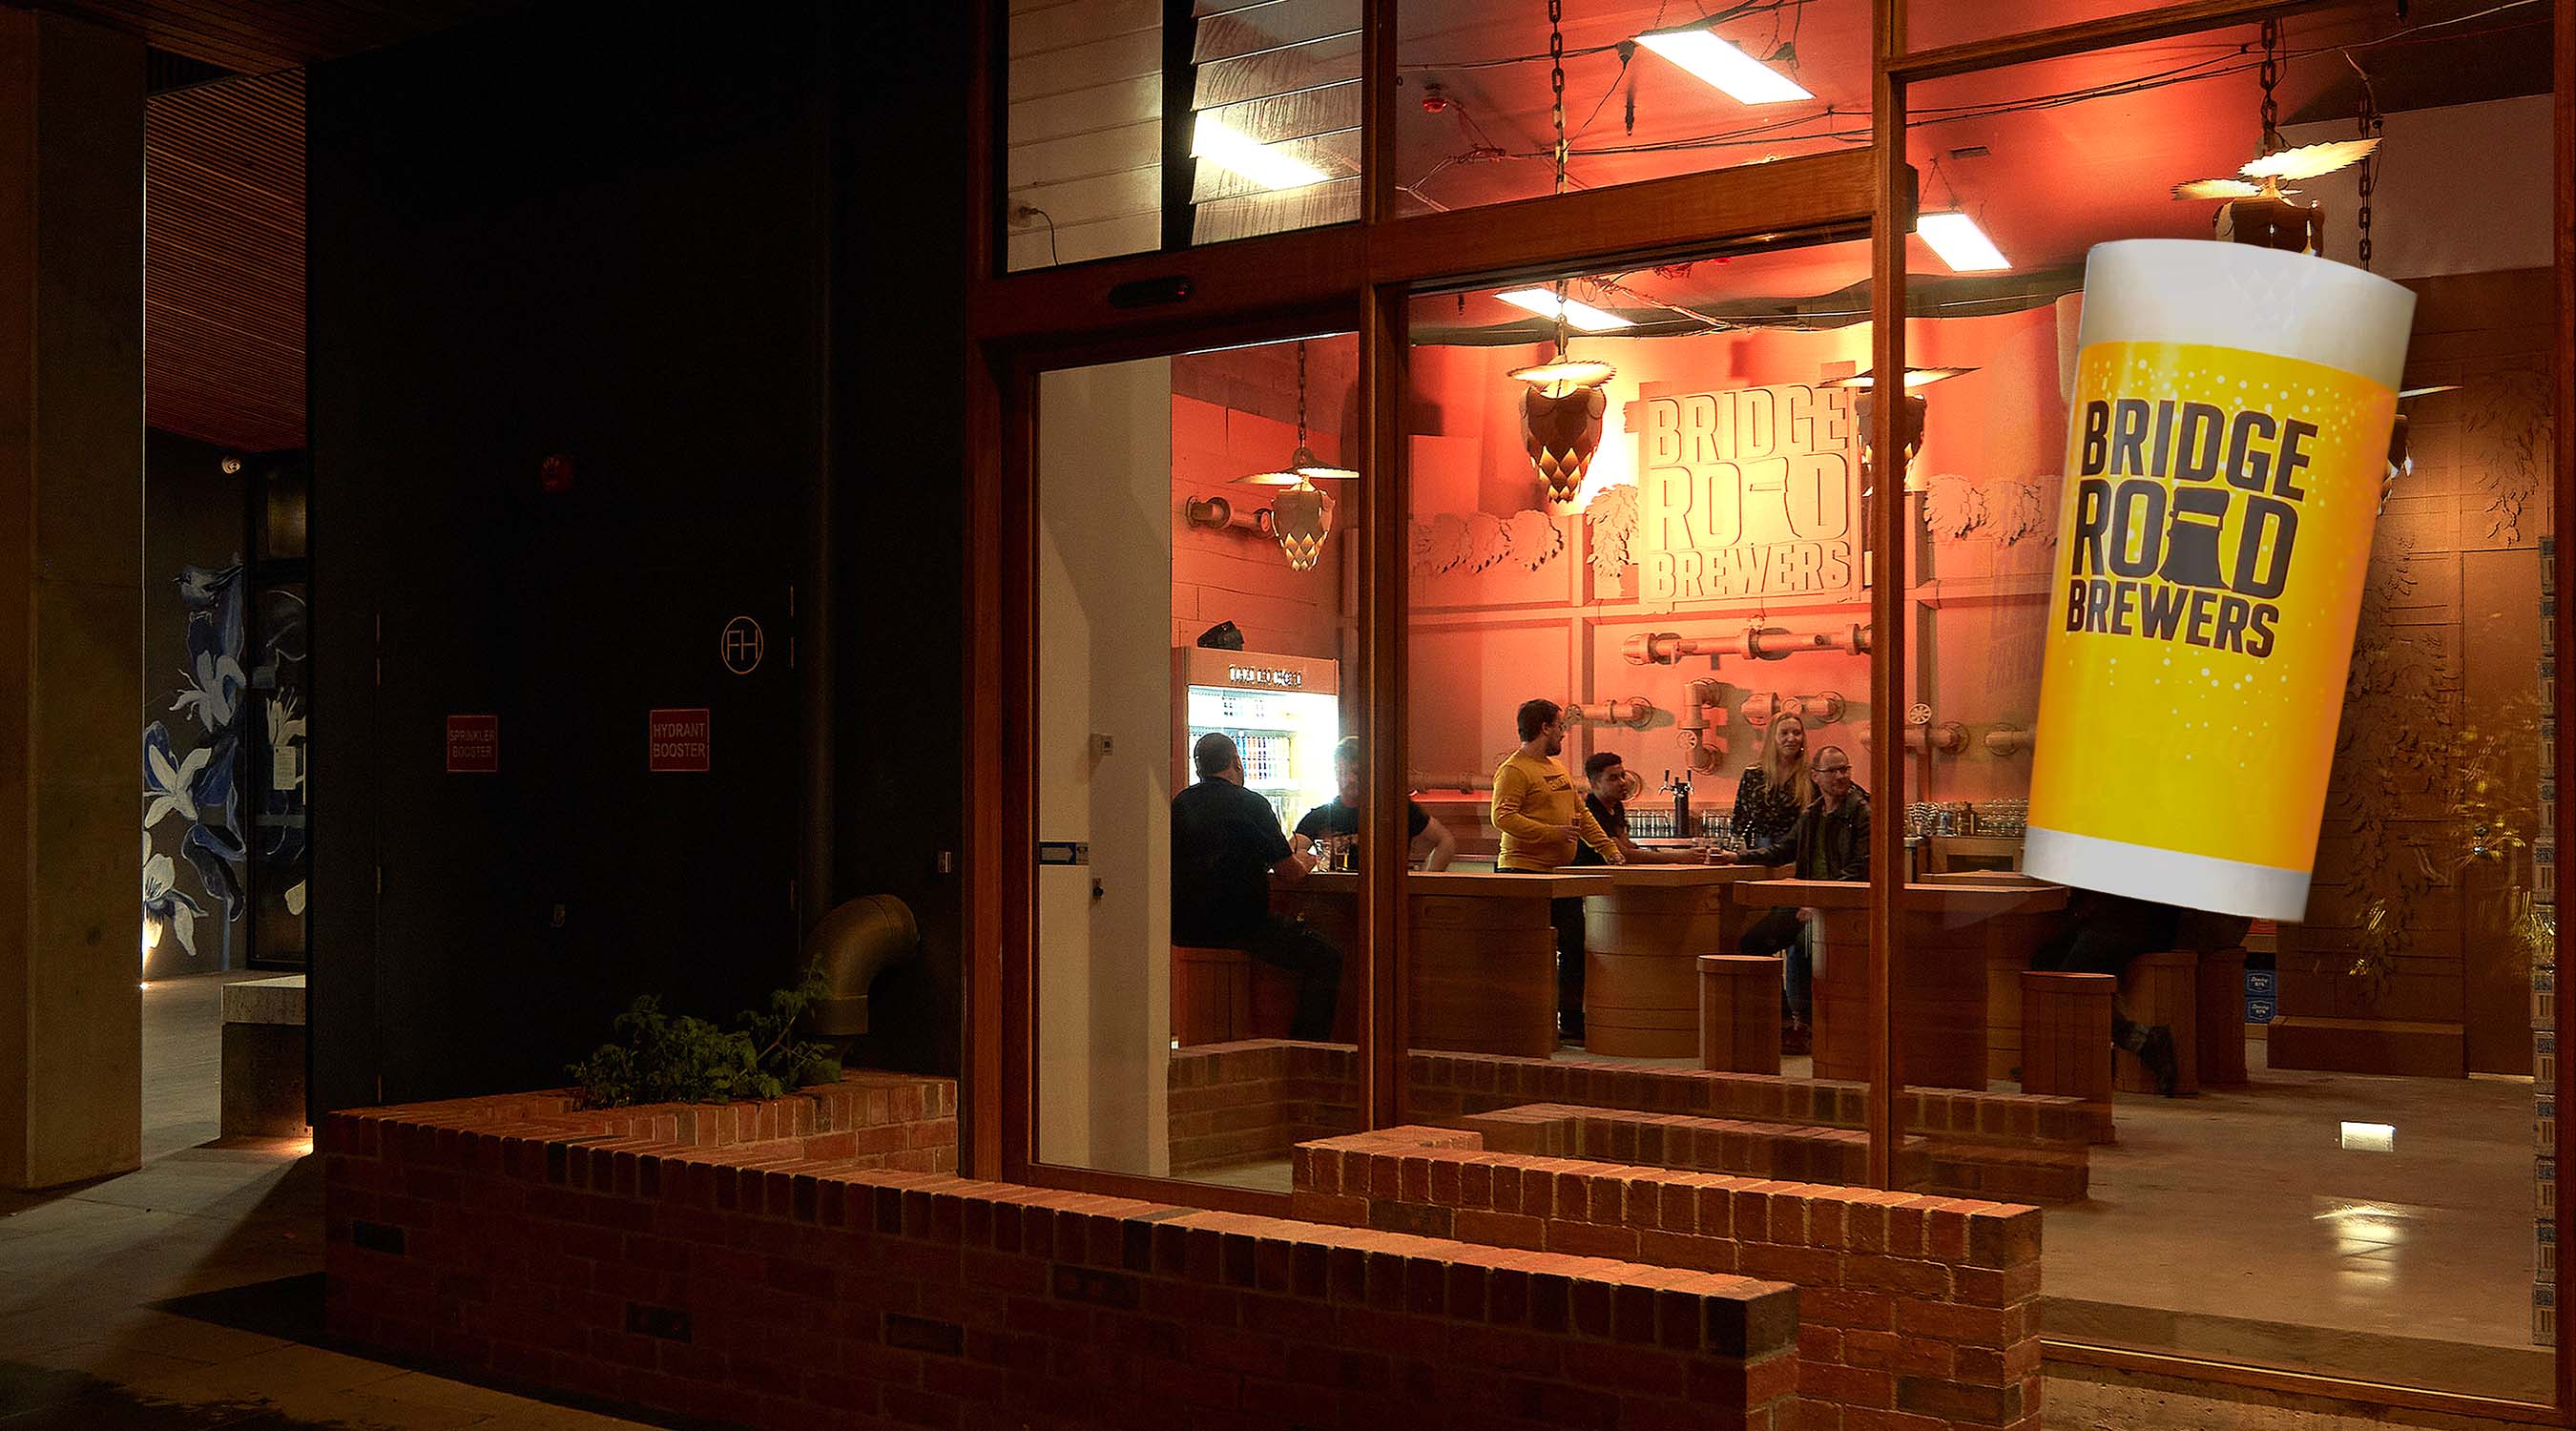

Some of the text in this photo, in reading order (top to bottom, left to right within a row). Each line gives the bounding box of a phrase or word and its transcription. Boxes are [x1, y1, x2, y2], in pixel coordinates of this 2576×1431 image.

[1649, 384, 1849, 466] BRIDGE
[2080, 398, 2319, 502] BRIDGE
[1649, 540, 1852, 599] BREWERS
[2066, 578, 2279, 658] BREWERS
[653, 742, 706, 758] BOOSTER
[654, 722, 705, 738] HYDRANT
